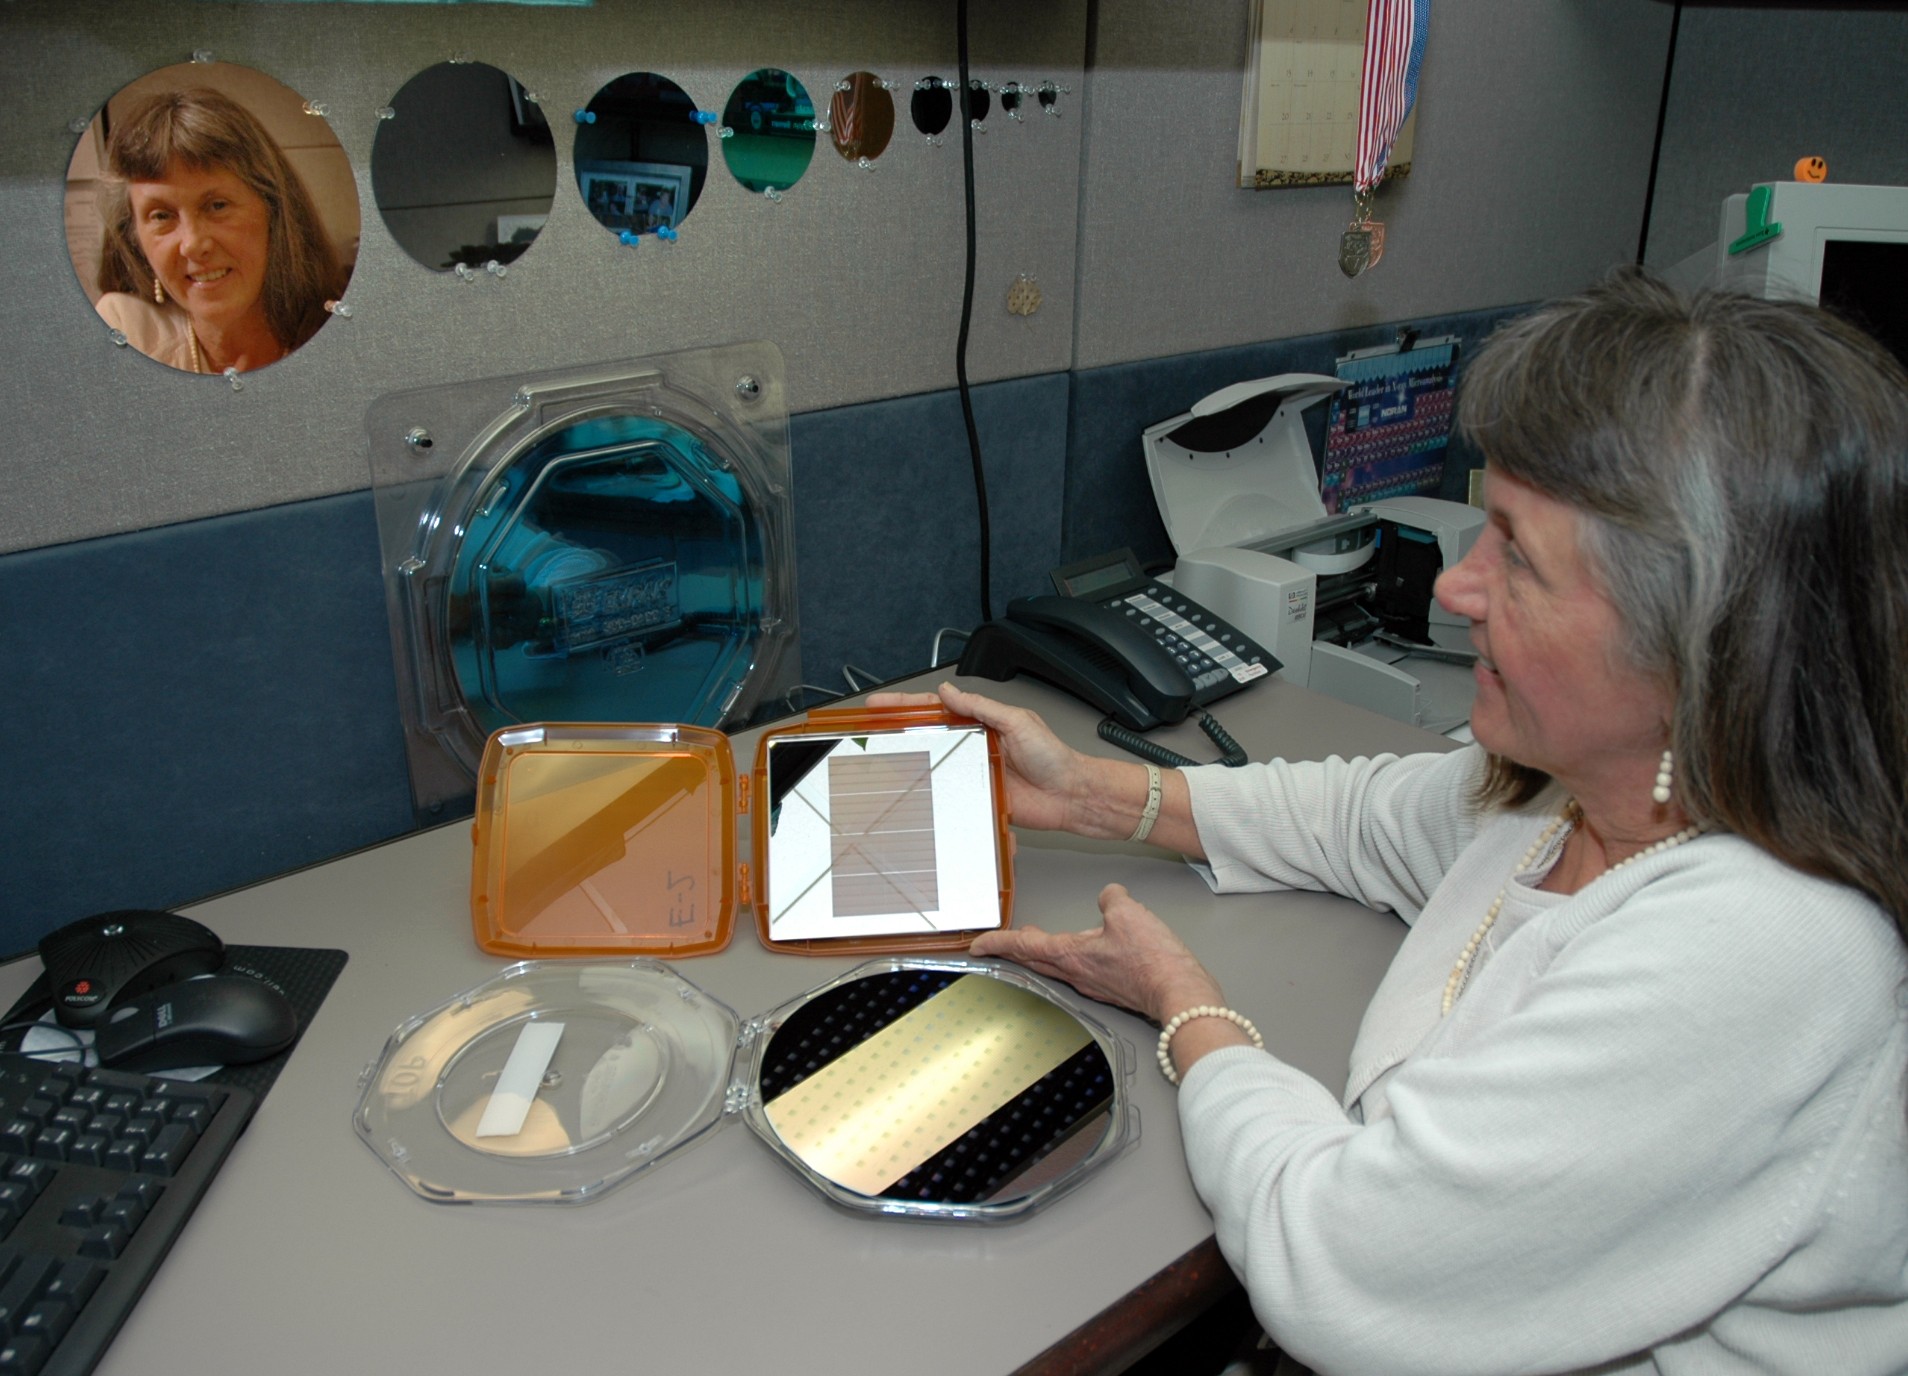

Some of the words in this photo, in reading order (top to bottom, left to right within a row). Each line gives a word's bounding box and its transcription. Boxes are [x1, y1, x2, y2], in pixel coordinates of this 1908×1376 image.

[1381, 405, 1407, 418] NORAN
[64, 995, 97, 1003] POLYCOM
[158, 1005, 168, 1029] DELL
